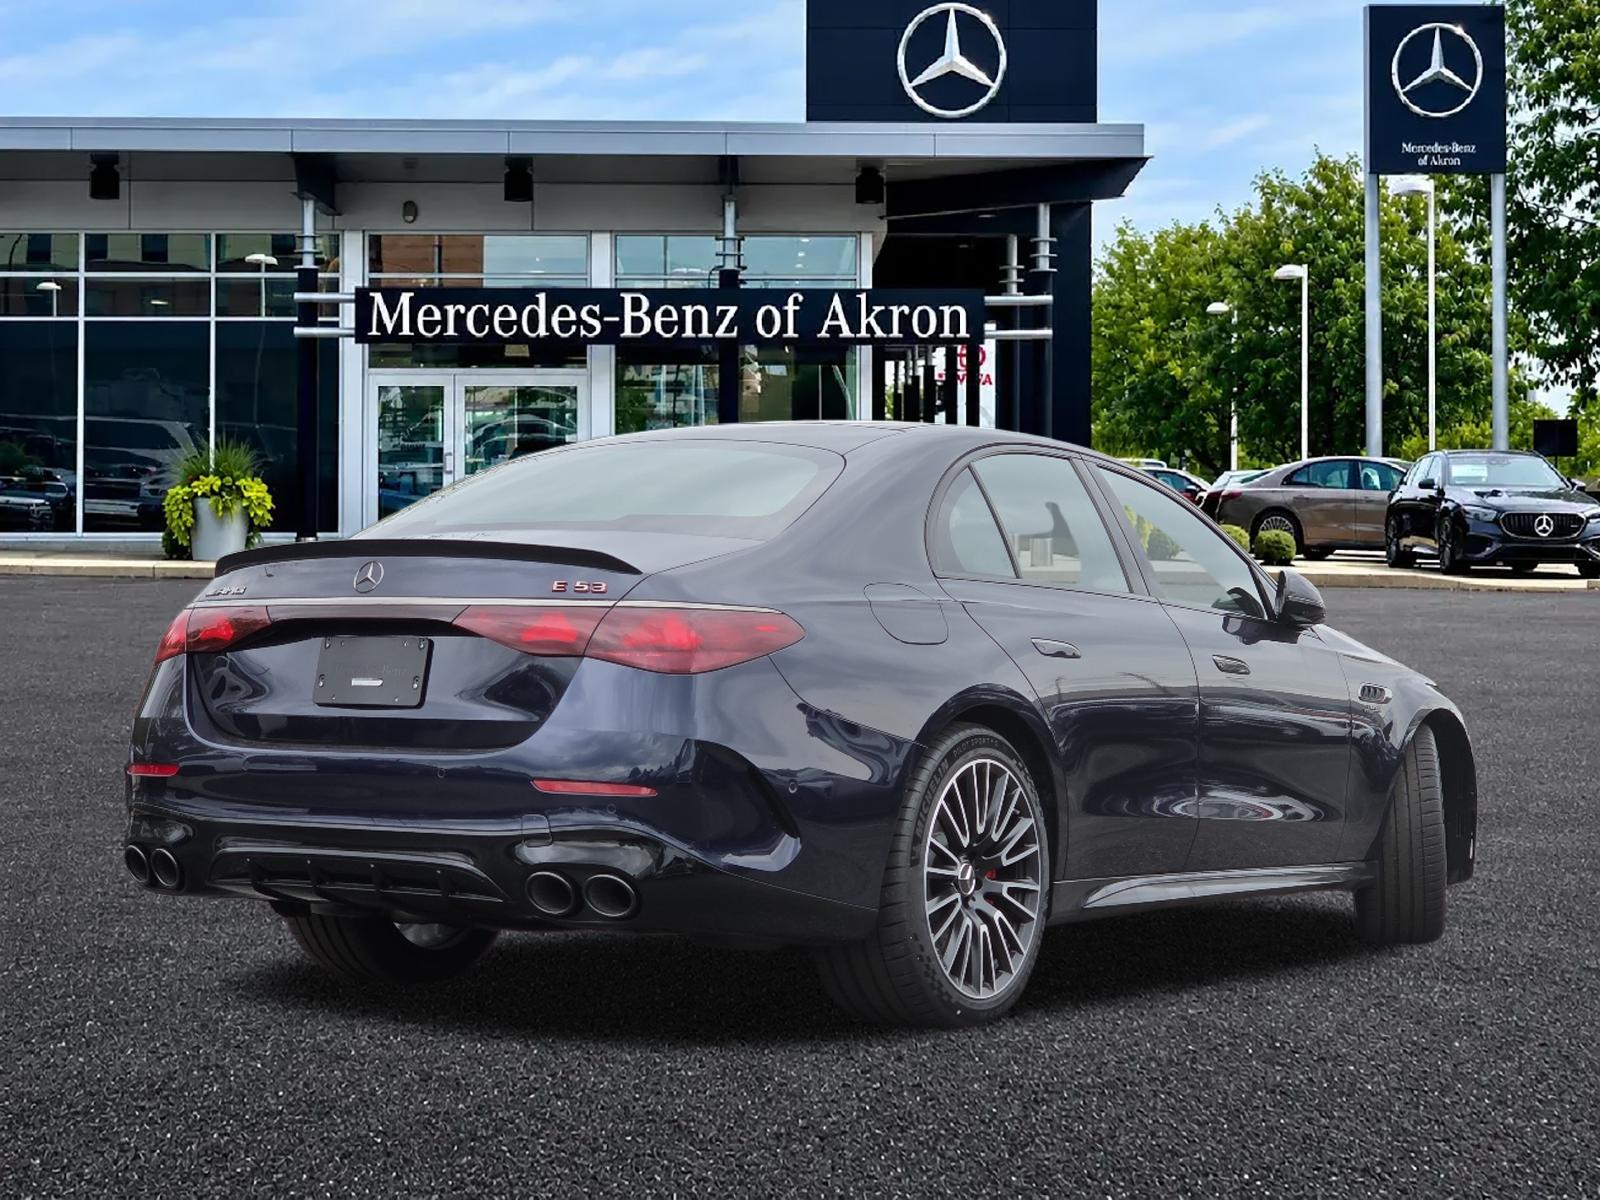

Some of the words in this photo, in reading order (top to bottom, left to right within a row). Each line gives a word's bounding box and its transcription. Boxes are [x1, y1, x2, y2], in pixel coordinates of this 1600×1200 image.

[1401, 142, 1477, 154] Mercedes-Benz
[1417, 154, 1429, 166] of
[1430, 154, 1461, 166] Akron
[367, 291, 738, 338] Mercedes-Benz
[756, 291, 804, 338] of
[816, 291, 970, 338] Akron
[551, 580, 568, 593] E
[573, 580, 608, 594] 53
[915, 758, 949, 839] MICHELIN
